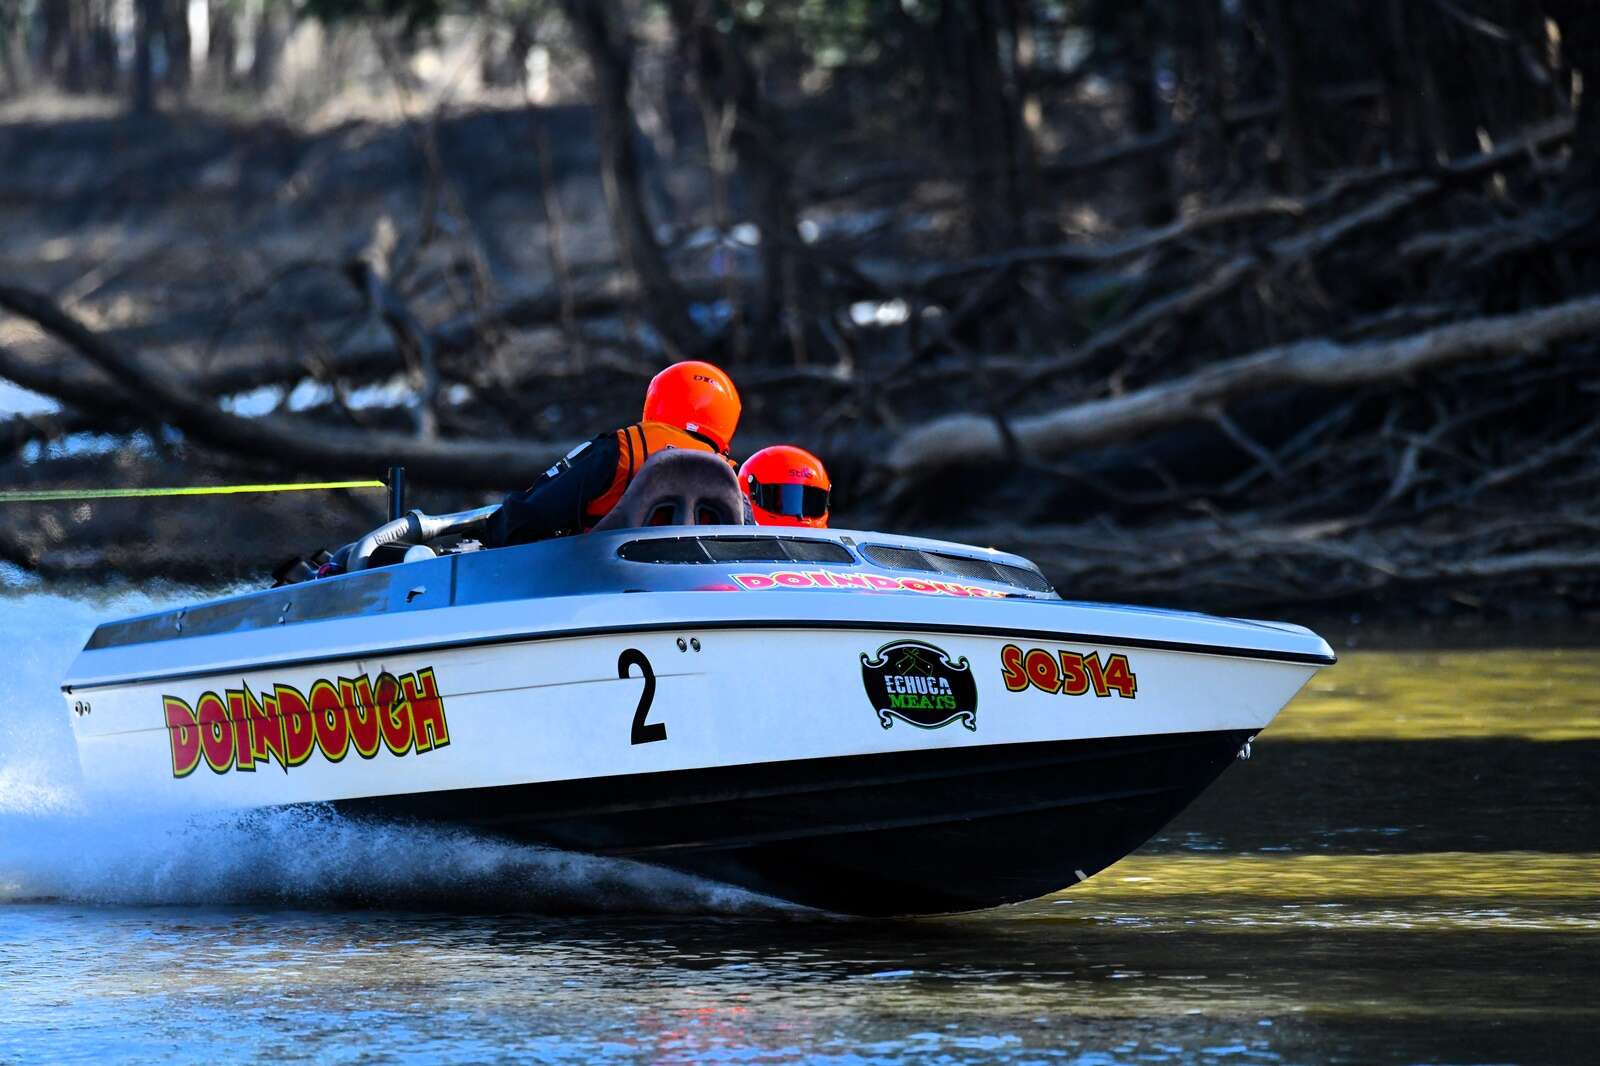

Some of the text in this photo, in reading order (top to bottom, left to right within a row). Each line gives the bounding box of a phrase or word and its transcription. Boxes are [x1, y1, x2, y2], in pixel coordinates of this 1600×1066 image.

[617, 648, 668, 746] 2
[884, 674, 953, 696] ECHUCA
[1000, 643, 1138, 700] SQ514
[161, 664, 451, 779] DOINDOUGH
[888, 694, 957, 711] MEATS
